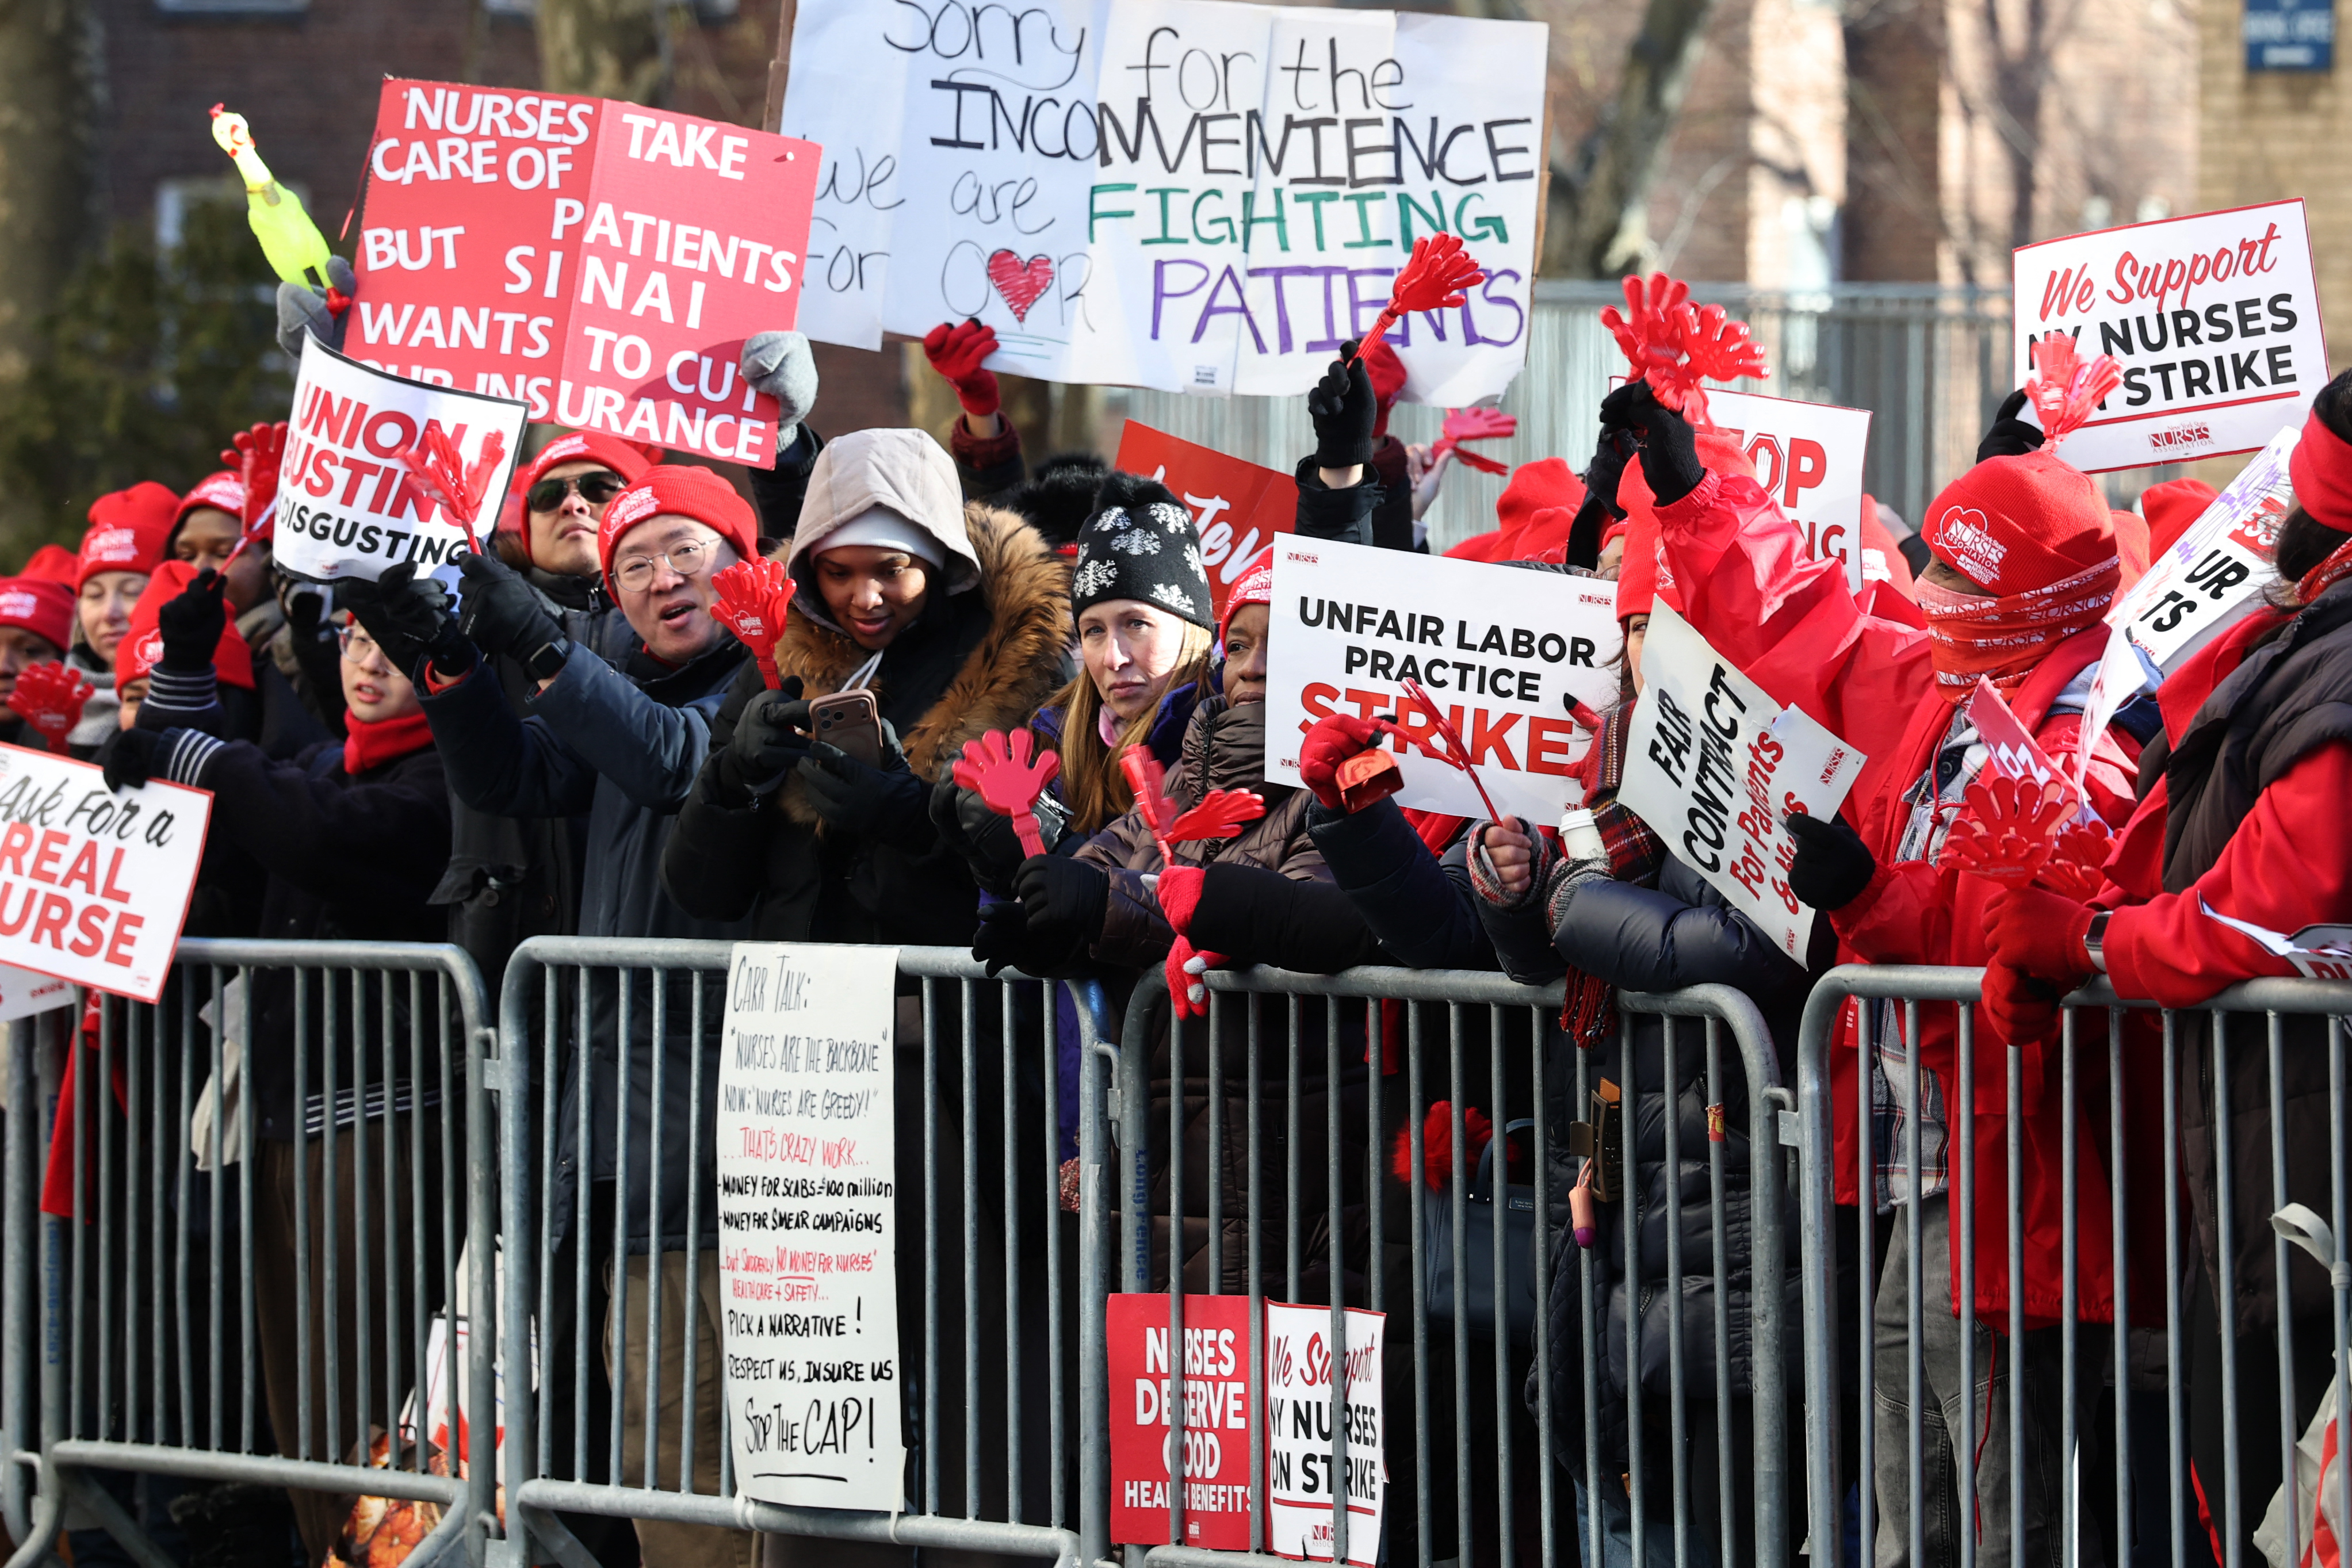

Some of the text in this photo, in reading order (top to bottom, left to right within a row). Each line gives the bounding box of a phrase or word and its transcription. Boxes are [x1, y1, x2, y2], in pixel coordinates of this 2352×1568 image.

[1126, 27, 1256, 110] for
[1280, 37, 1413, 113] the
[404, 87, 748, 180] NURSES TAKE
[931, 80, 1535, 188] INCONVENIENCE
[372, 136, 572, 190] CARE OF
[951, 171, 1055, 235] are
[1088, 183, 1509, 253] FIGHTING
[364, 225, 464, 271] BUT
[551, 198, 796, 292] PATIENTS
[2040, 222, 2281, 322] We Support
[359, 301, 553, 358] WANTS
[583, 326, 652, 379] TO
[2099, 293, 2298, 357] NURSES
[2123, 345, 2297, 407] STRIKE
[2148, 426, 2210, 448] NURSES
[2153, 437, 2215, 454] ASSOCIATION
[1948, 518, 2003, 564] NURSES
[1299, 596, 1596, 667] UNFAIR LABOR
[1345, 645, 1542, 703] PRACTICE
[1648, 689, 1691, 789] FAIR
[1682, 663, 1747, 874] CONTRACT
[146, 809, 175, 847] a
[0, 821, 132, 904] REAL
[780, 1034, 801, 1073] ARE
[805, 1037, 823, 1073] THE
[797, 1088, 817, 1119] ARE
[780, 1132, 817, 1167] CRAZY
[762, 1176, 780, 1197] FOR
[782, 1177, 816, 1199] SCABS
[847, 1177, 893, 1198] million
[752, 1211, 768, 1230] FOR
[771, 1207, 809, 1231] SMEAR
[777, 1245, 787, 1273] NO
[728, 1309, 754, 1337] PICK
[757, 1315, 764, 1336] A
[769, 1313, 846, 1338] NARRATIVE
[728, 1353, 775, 1380] RESPECT
[804, 1360, 865, 1383] INSURE
[871, 1359, 894, 1381] US
[1146, 1326, 1236, 1377] NRSES
[1272, 1335, 1293, 1387] We
[1269, 1395, 1377, 1448] NY NURSES
[1272, 1448, 1376, 1501] ON STRIKE
